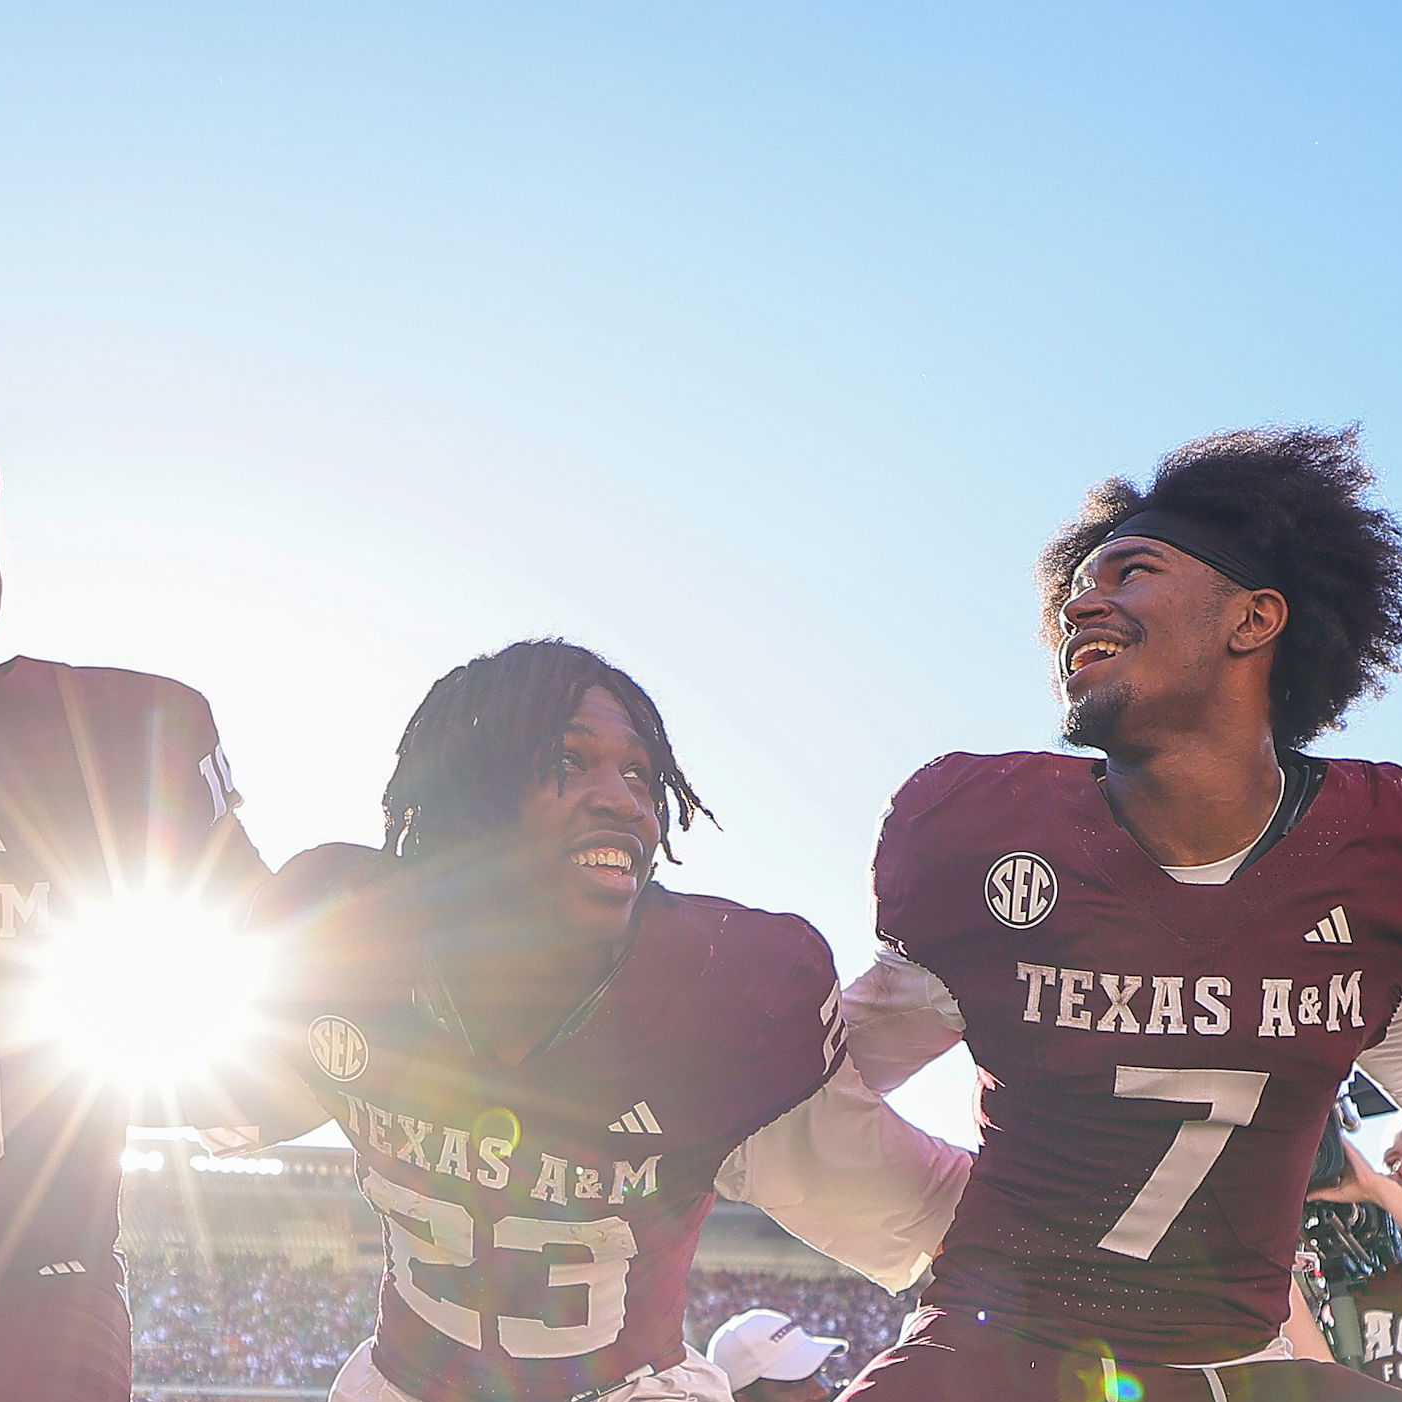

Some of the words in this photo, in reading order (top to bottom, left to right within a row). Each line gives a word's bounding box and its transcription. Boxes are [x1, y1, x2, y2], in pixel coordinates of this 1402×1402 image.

[990, 856, 1053, 923] SEC
[1016, 961, 1233, 1036] TEXAS
[1257, 970, 1367, 1038] A&M
[311, 1019, 365, 1078] SEC
[337, 1091, 513, 1191] TEXAS
[530, 1153, 663, 1206] A&M
[1097, 1063, 1271, 1262] 7
[362, 1166, 639, 1360] 23
